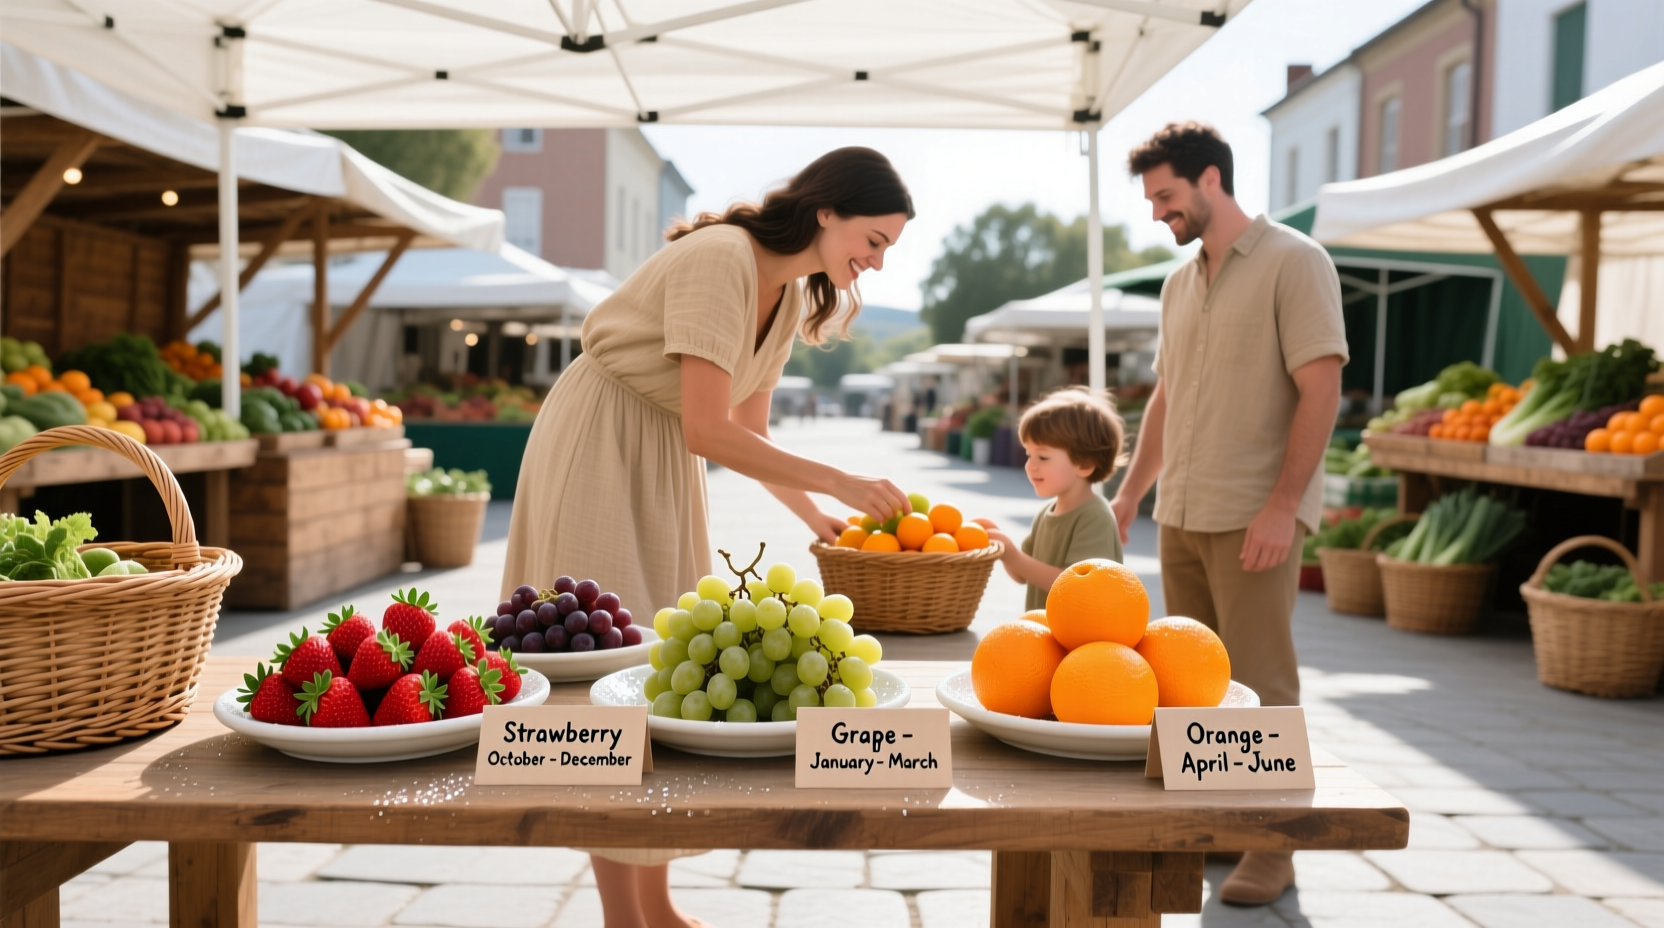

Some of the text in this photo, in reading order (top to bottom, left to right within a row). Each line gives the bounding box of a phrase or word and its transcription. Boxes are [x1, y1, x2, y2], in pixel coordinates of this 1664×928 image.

[503, 721, 622, 750] Strawberry
[831, 722, 896, 752] Grape
[1186, 722, 1263, 753] Orange
[488, 750, 545, 766] October
[560, 751, 632, 766] December
[810, 752, 874, 775] January
[888, 752, 938, 769] March
[1181, 751, 1228, 781] April
[1248, 751, 1296, 773] June
